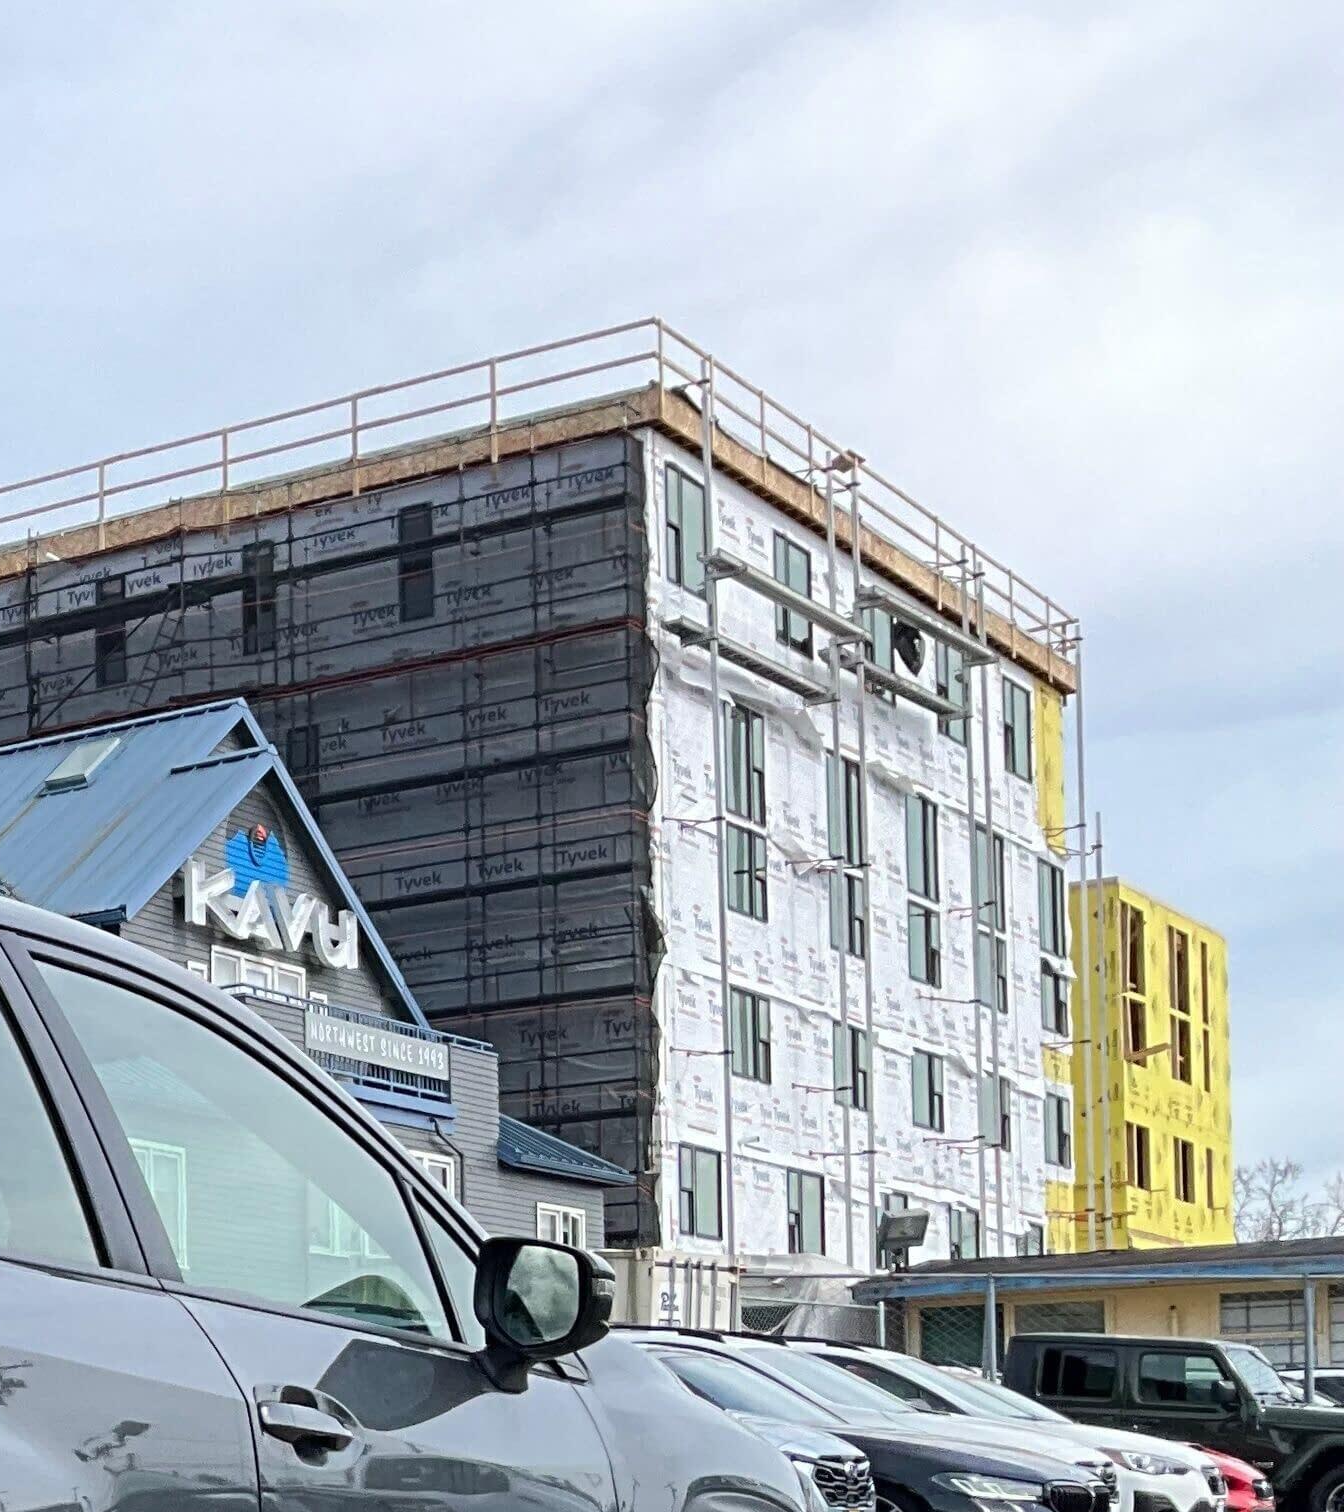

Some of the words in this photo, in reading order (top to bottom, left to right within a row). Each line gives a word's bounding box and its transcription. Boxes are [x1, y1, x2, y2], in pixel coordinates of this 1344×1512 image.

[126, 573, 162, 595] yvek
[468, 706, 507, 729] yvek
[381, 721, 426, 744] Tyvek
[557, 845, 608, 867] Tyvek
[476, 857, 525, 881] Tyvek
[394, 872, 442, 893] Tyvek
[184, 856, 359, 970] KAVU
[603, 1017, 633, 1037] Tyv
[310, 1022, 375, 1053] NORTHWEST
[380, 1038, 413, 1063] SINCE
[418, 1047, 444, 1070] 1993
